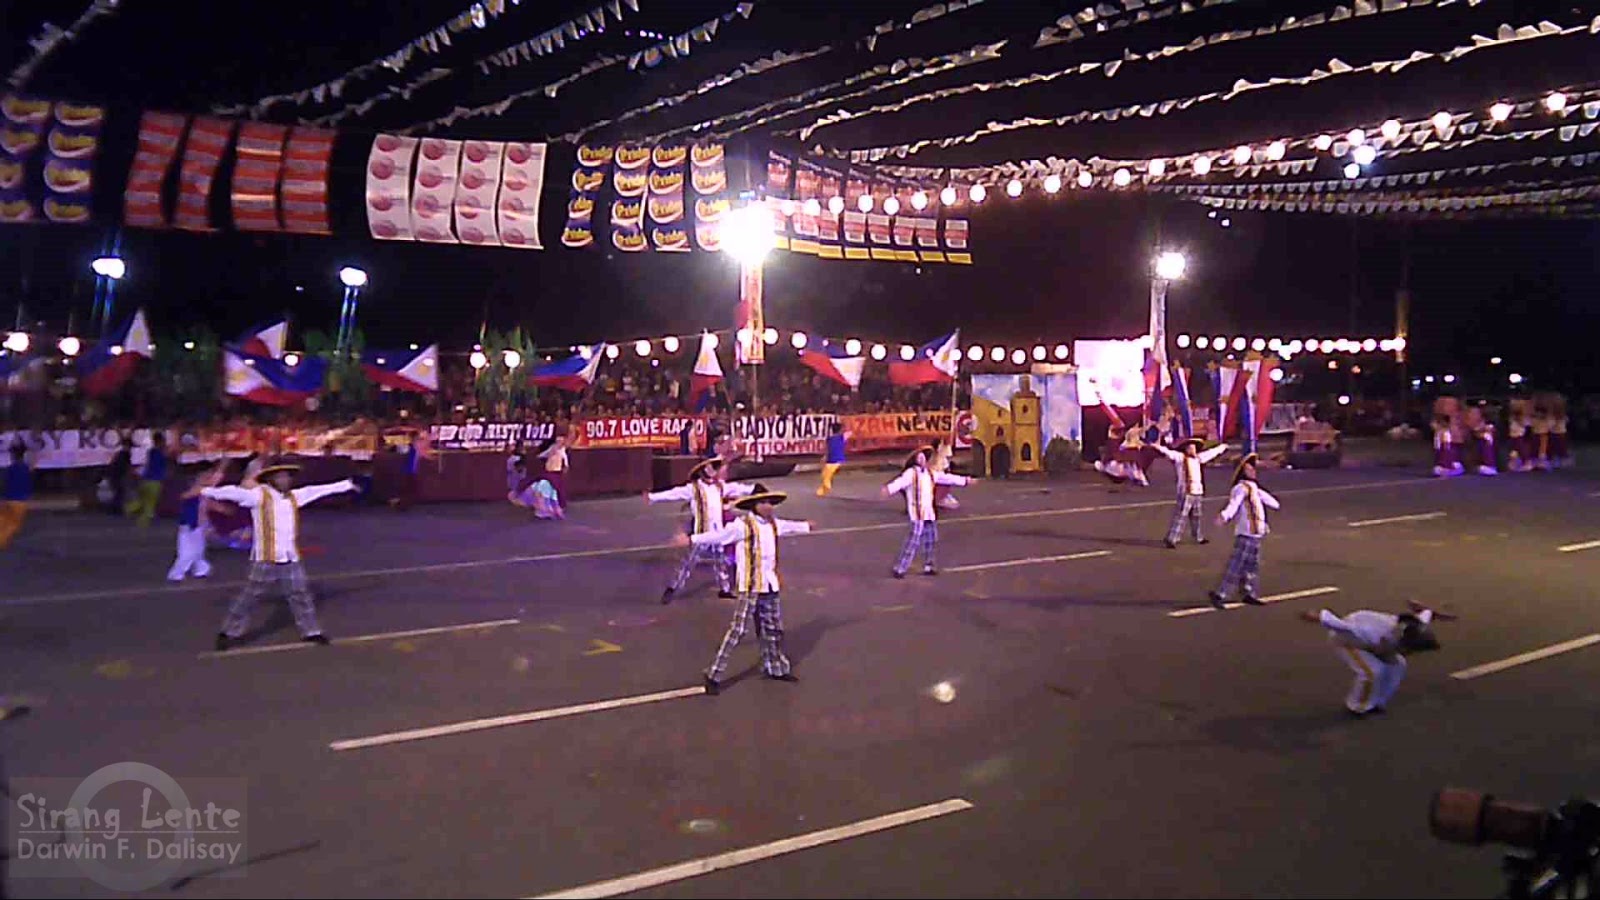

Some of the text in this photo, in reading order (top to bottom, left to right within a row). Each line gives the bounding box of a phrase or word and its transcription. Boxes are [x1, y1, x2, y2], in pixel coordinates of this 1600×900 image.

[586, 421, 617, 437] 90.7
[621, 419, 659, 435] LOVE
[897, 414, 952, 432] NEWS
